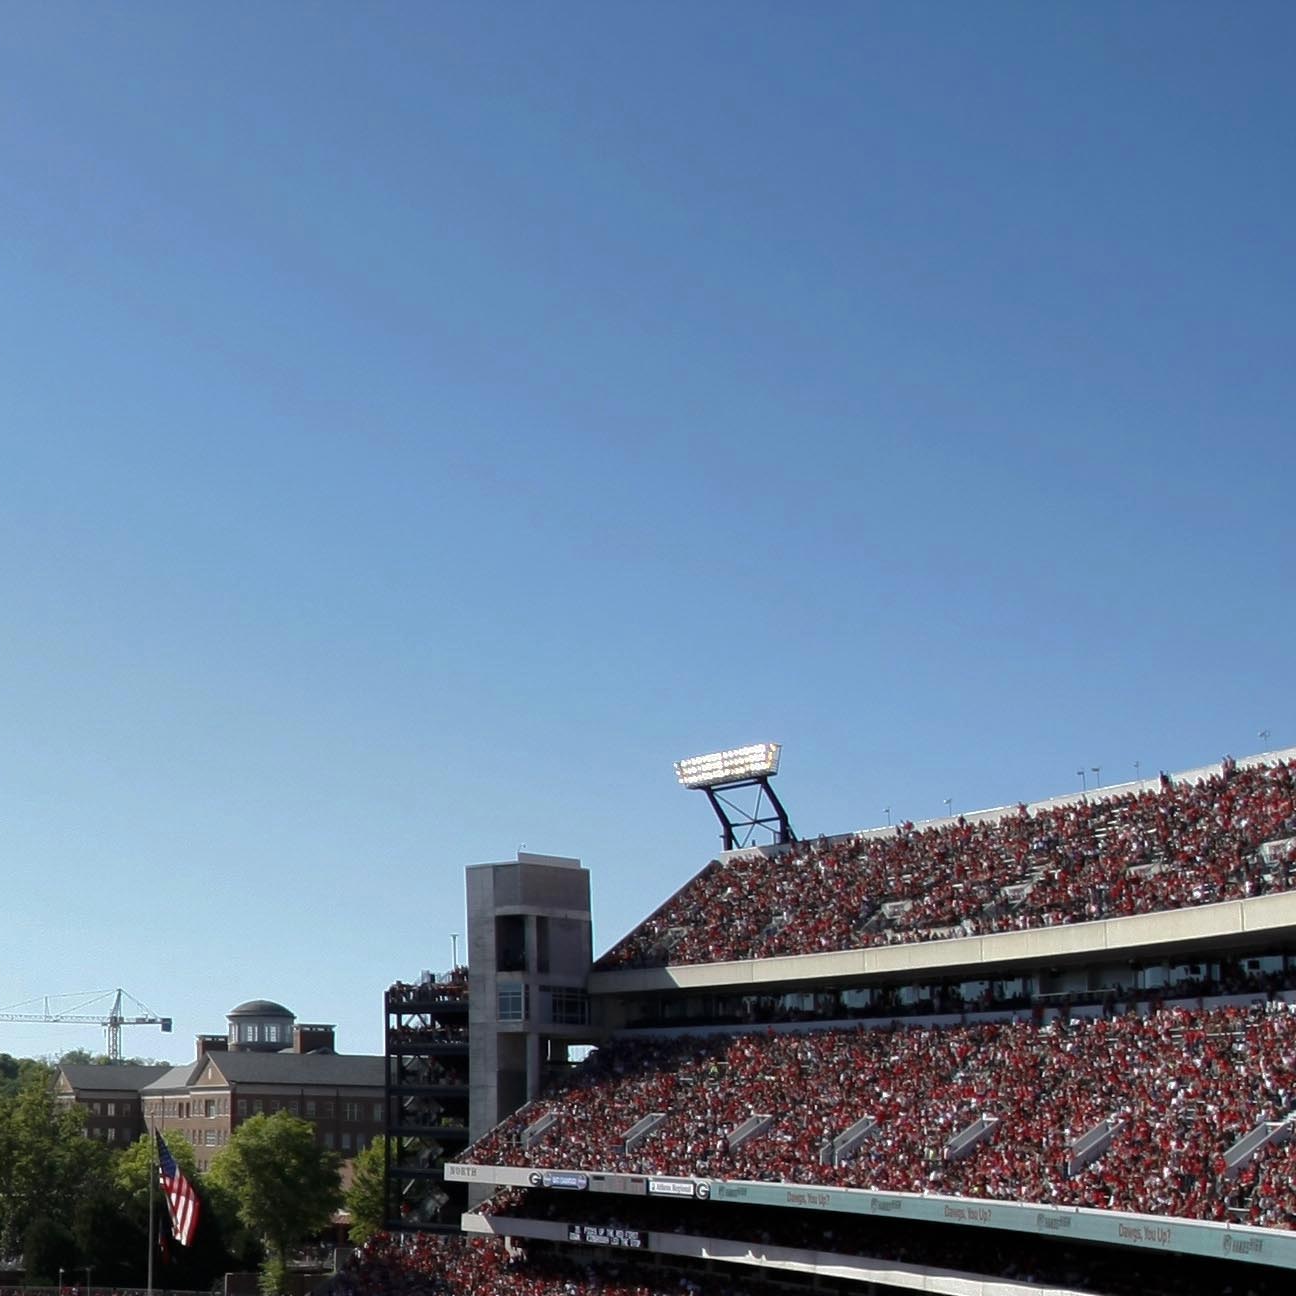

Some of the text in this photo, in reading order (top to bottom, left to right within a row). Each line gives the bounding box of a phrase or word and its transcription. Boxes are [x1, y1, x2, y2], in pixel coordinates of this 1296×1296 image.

[450, 1167, 477, 1176] NORTH
[807, 1193, 818, 1204] You
[819, 1194, 831, 1207] Up?
[967, 1207, 977, 1219] You
[978, 1208, 992, 1224] Up?
[1144, 1227, 1156, 1242] You
[1157, 1229, 1171, 1246] Up?
